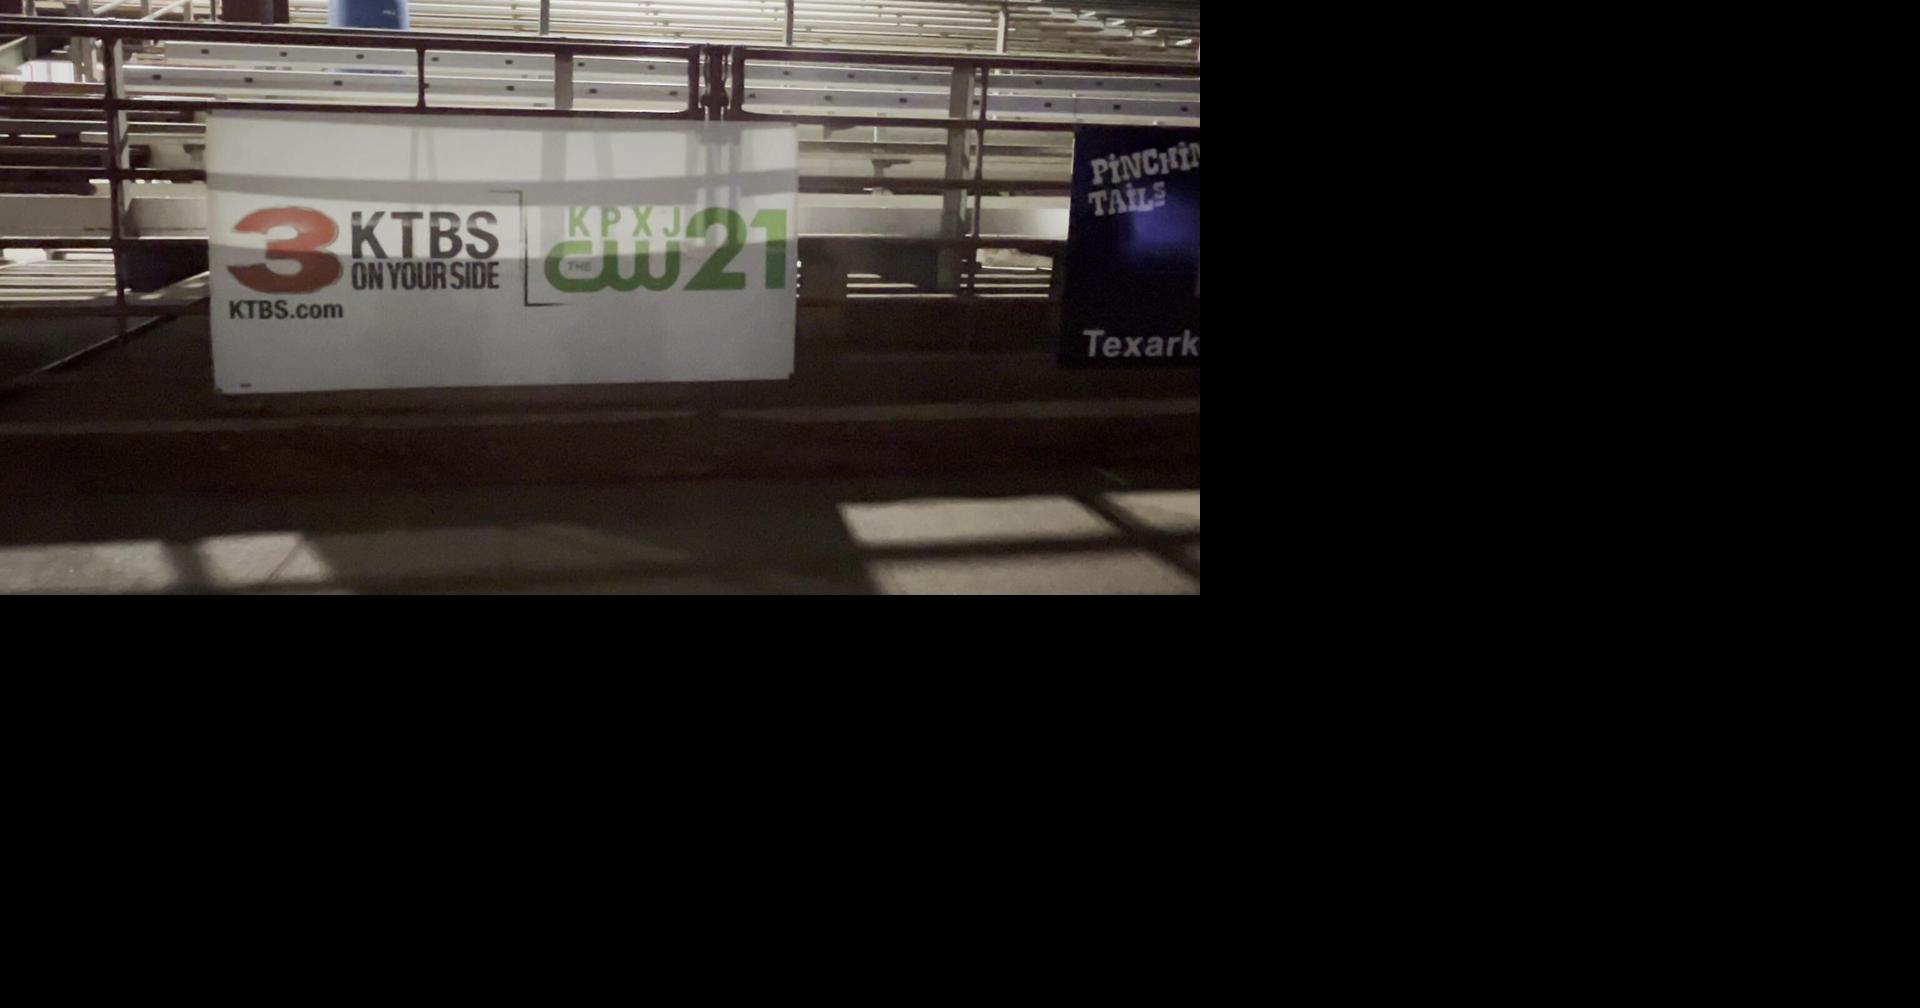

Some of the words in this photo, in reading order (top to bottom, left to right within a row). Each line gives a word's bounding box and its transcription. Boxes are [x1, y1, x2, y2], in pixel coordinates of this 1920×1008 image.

[568, 206, 681, 238] KPXJ
[227, 206, 344, 294] 3
[351, 211, 499, 260] KTBS
[682, 206, 788, 291] 21
[352, 262, 384, 290] ON
[388, 262, 447, 290] YOUR
[450, 262, 500, 290] SIDE
[568, 260, 593, 272] THE
[229, 300, 344, 319] KTBS.com
